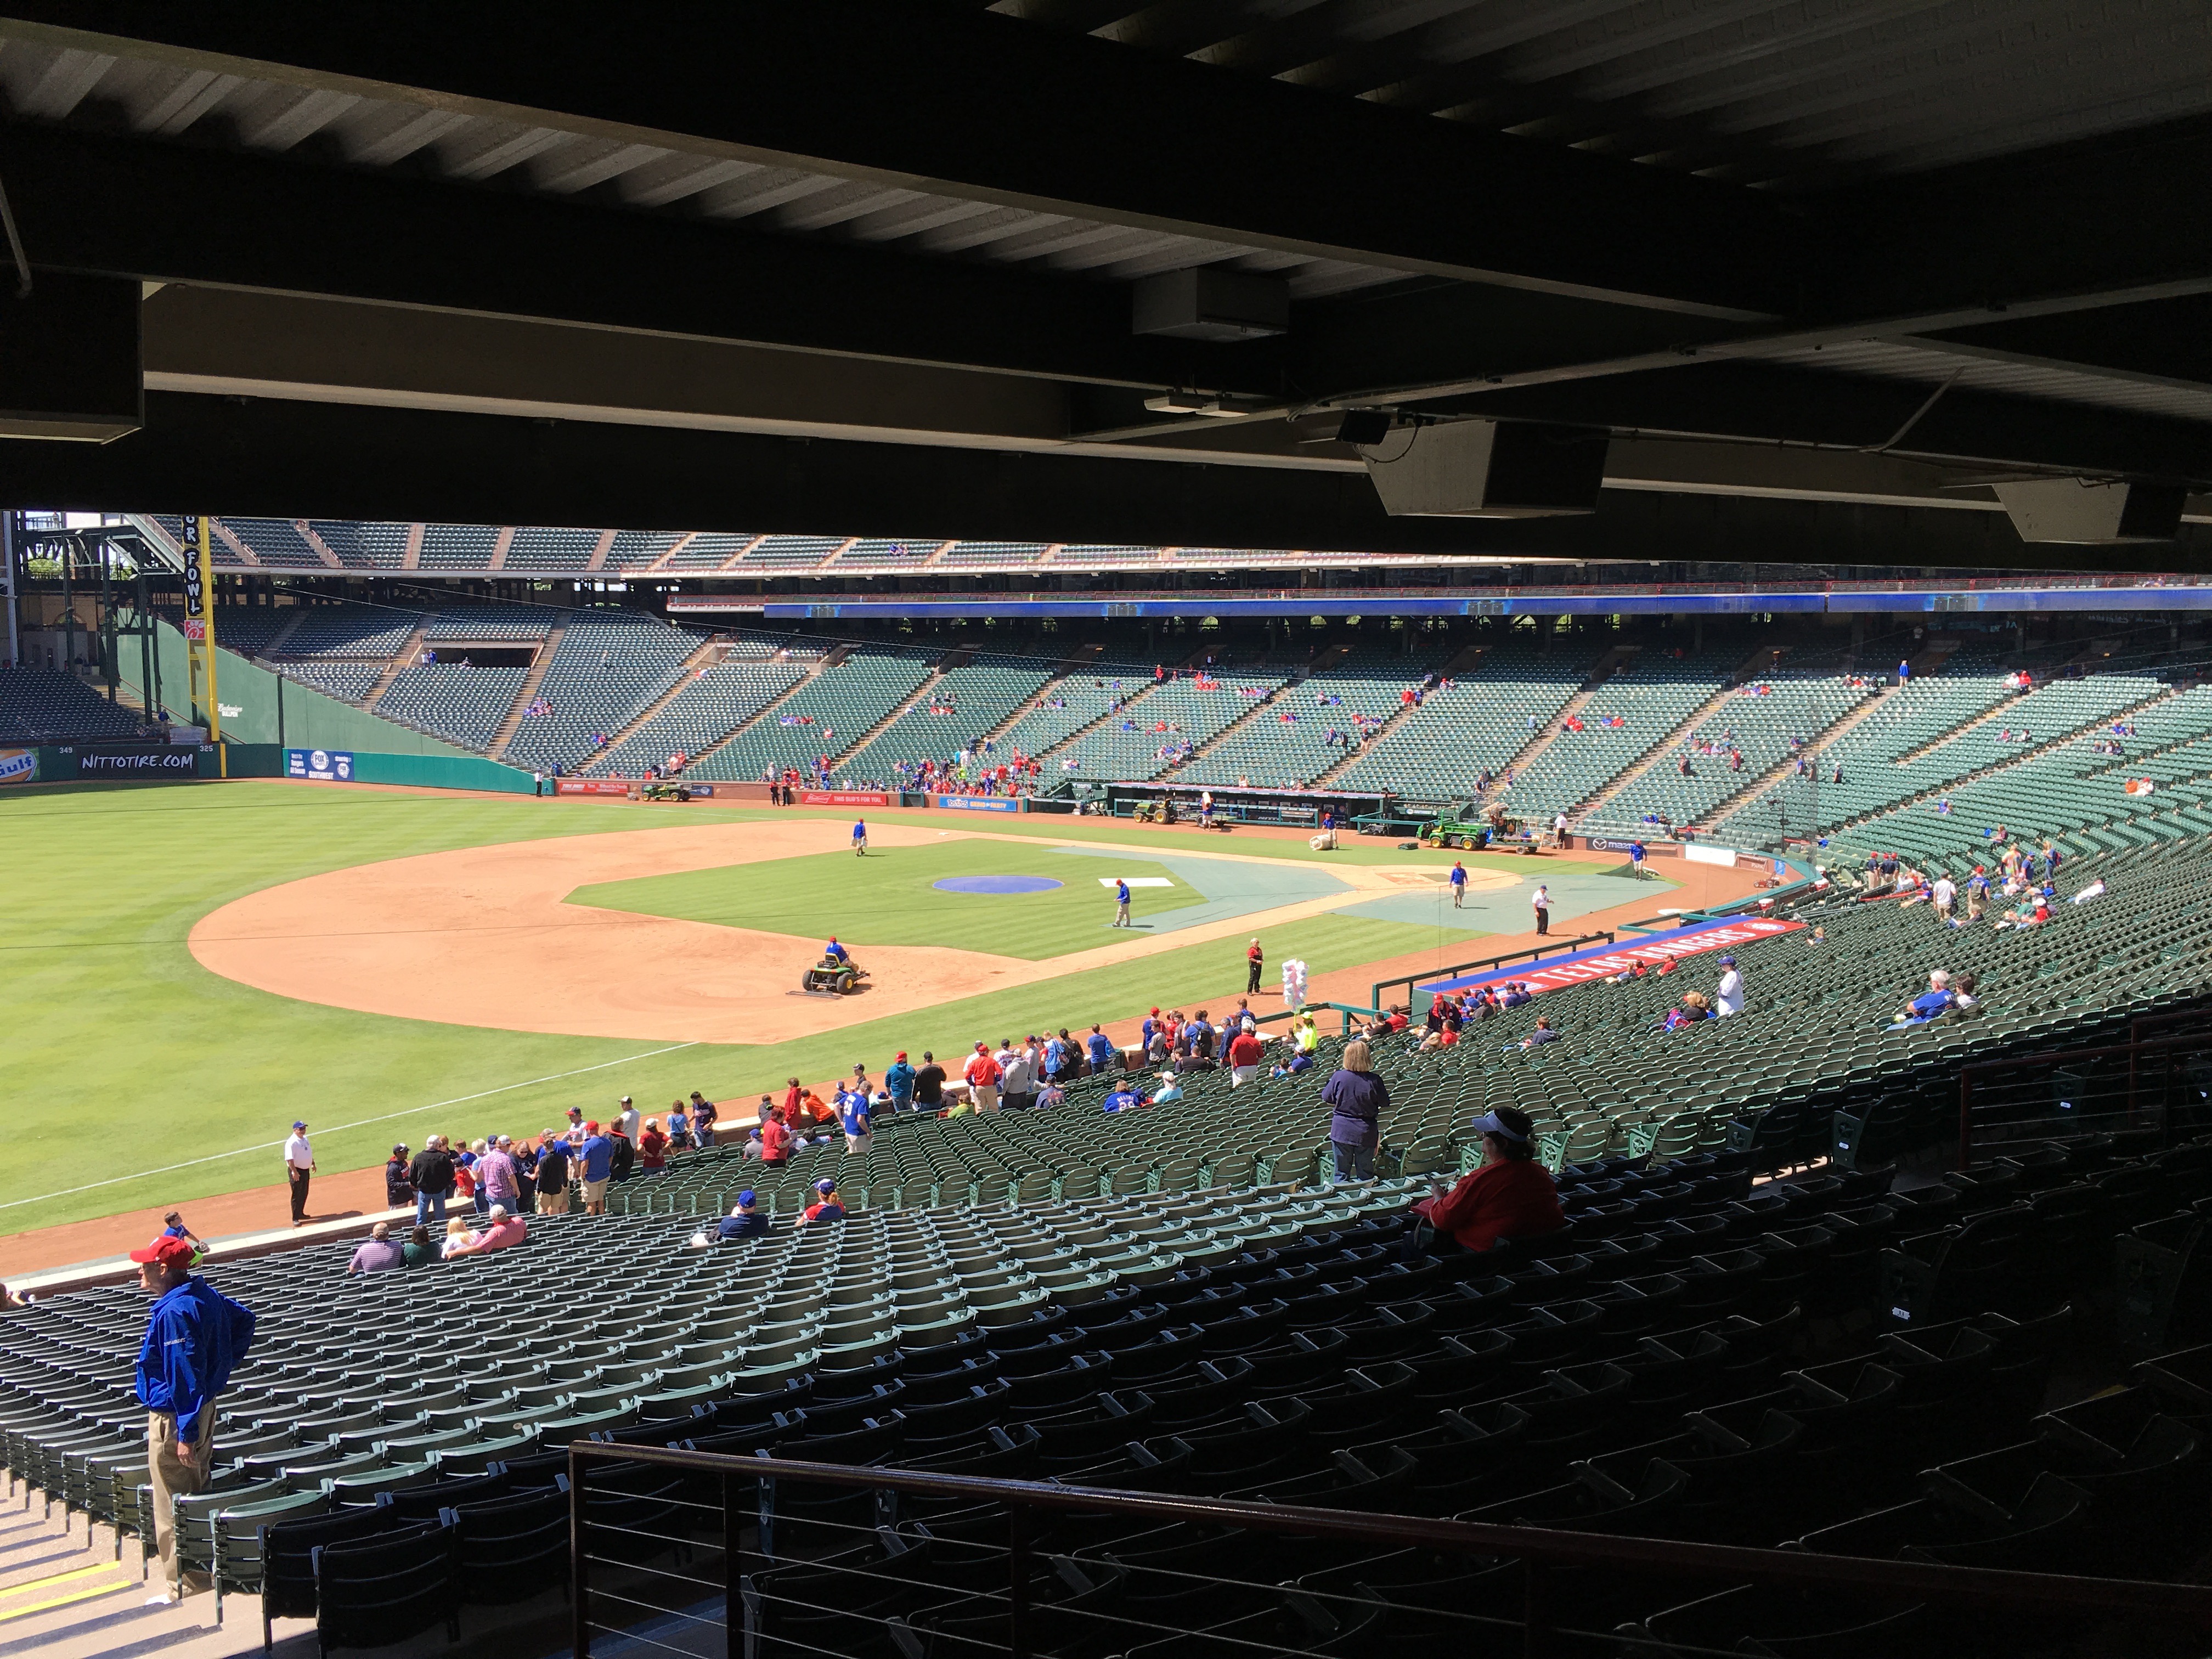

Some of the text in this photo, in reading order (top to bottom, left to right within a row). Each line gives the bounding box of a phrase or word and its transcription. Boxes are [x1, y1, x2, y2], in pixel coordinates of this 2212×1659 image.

[187, 551, 200, 613] FOWL
[217, 703, 242, 712] Budweiser
[82, 753, 194, 769] NITTOTIRE.COM
[308, 771, 334, 780] SOUTHWEST
[1531, 929, 1756, 981] TEXAS RANGERS
[843, 1101, 853, 1115] 29
